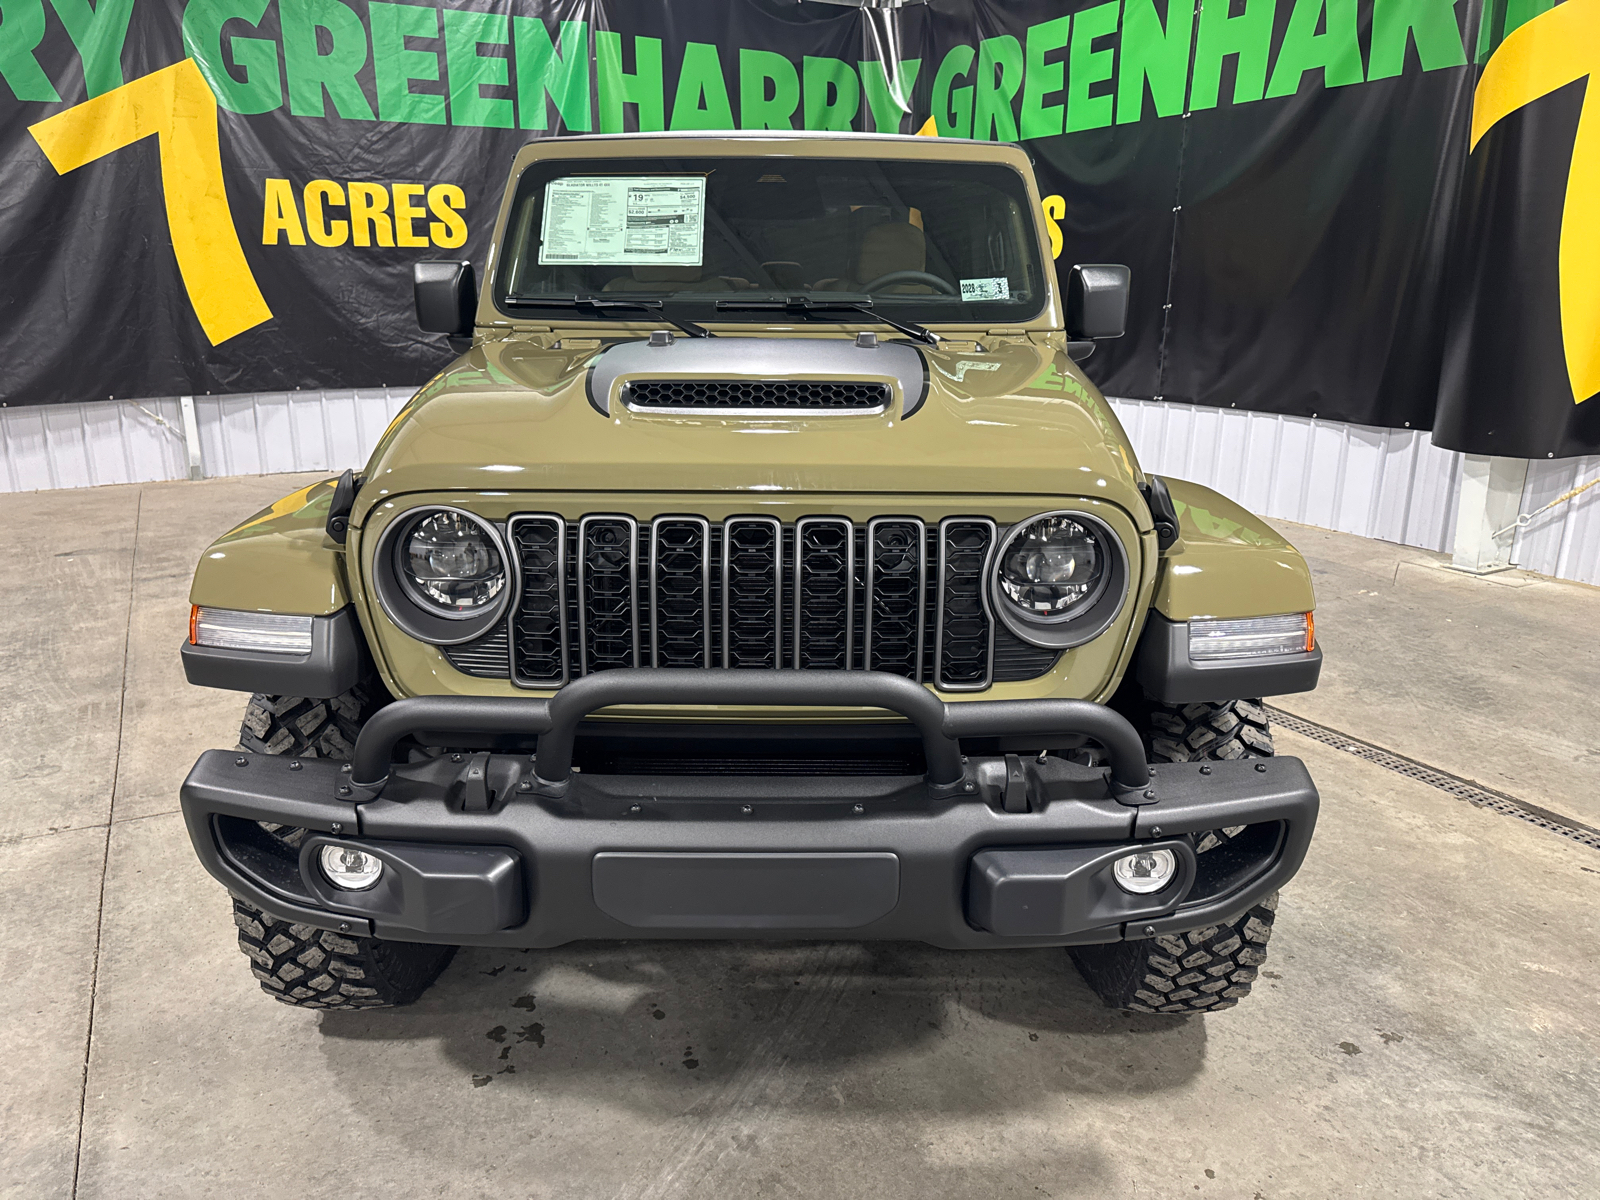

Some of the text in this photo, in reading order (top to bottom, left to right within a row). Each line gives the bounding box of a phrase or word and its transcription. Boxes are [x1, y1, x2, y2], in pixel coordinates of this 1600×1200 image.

[182, 0, 593, 132] GREEN
[596, 0, 1194, 142] HARRY GREEN
[262, 178, 468, 249] ACRES
[633, 194, 644, 202] 19
